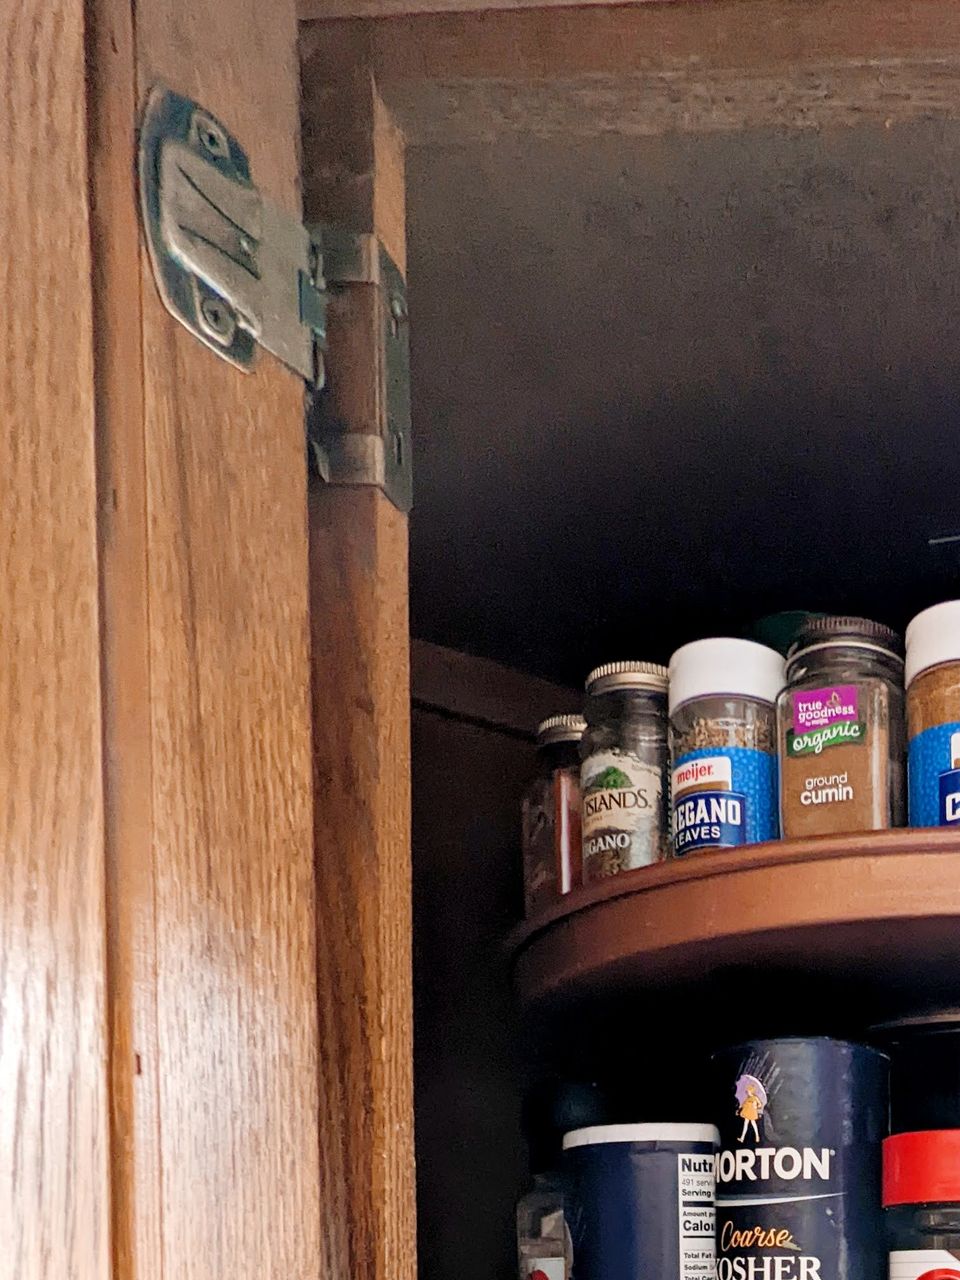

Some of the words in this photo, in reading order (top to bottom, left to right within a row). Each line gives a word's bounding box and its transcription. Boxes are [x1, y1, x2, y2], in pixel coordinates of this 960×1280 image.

[798, 700, 822, 712] true
[798, 705, 855, 723] goodness
[793, 721, 860, 753] organic
[676, 763, 713, 784] meijer
[805, 771, 848, 790] ground
[801, 784, 853, 805] cumin
[682, 1189, 711, 1198] Serving
[721, 1220, 793, 1251] Coarse
